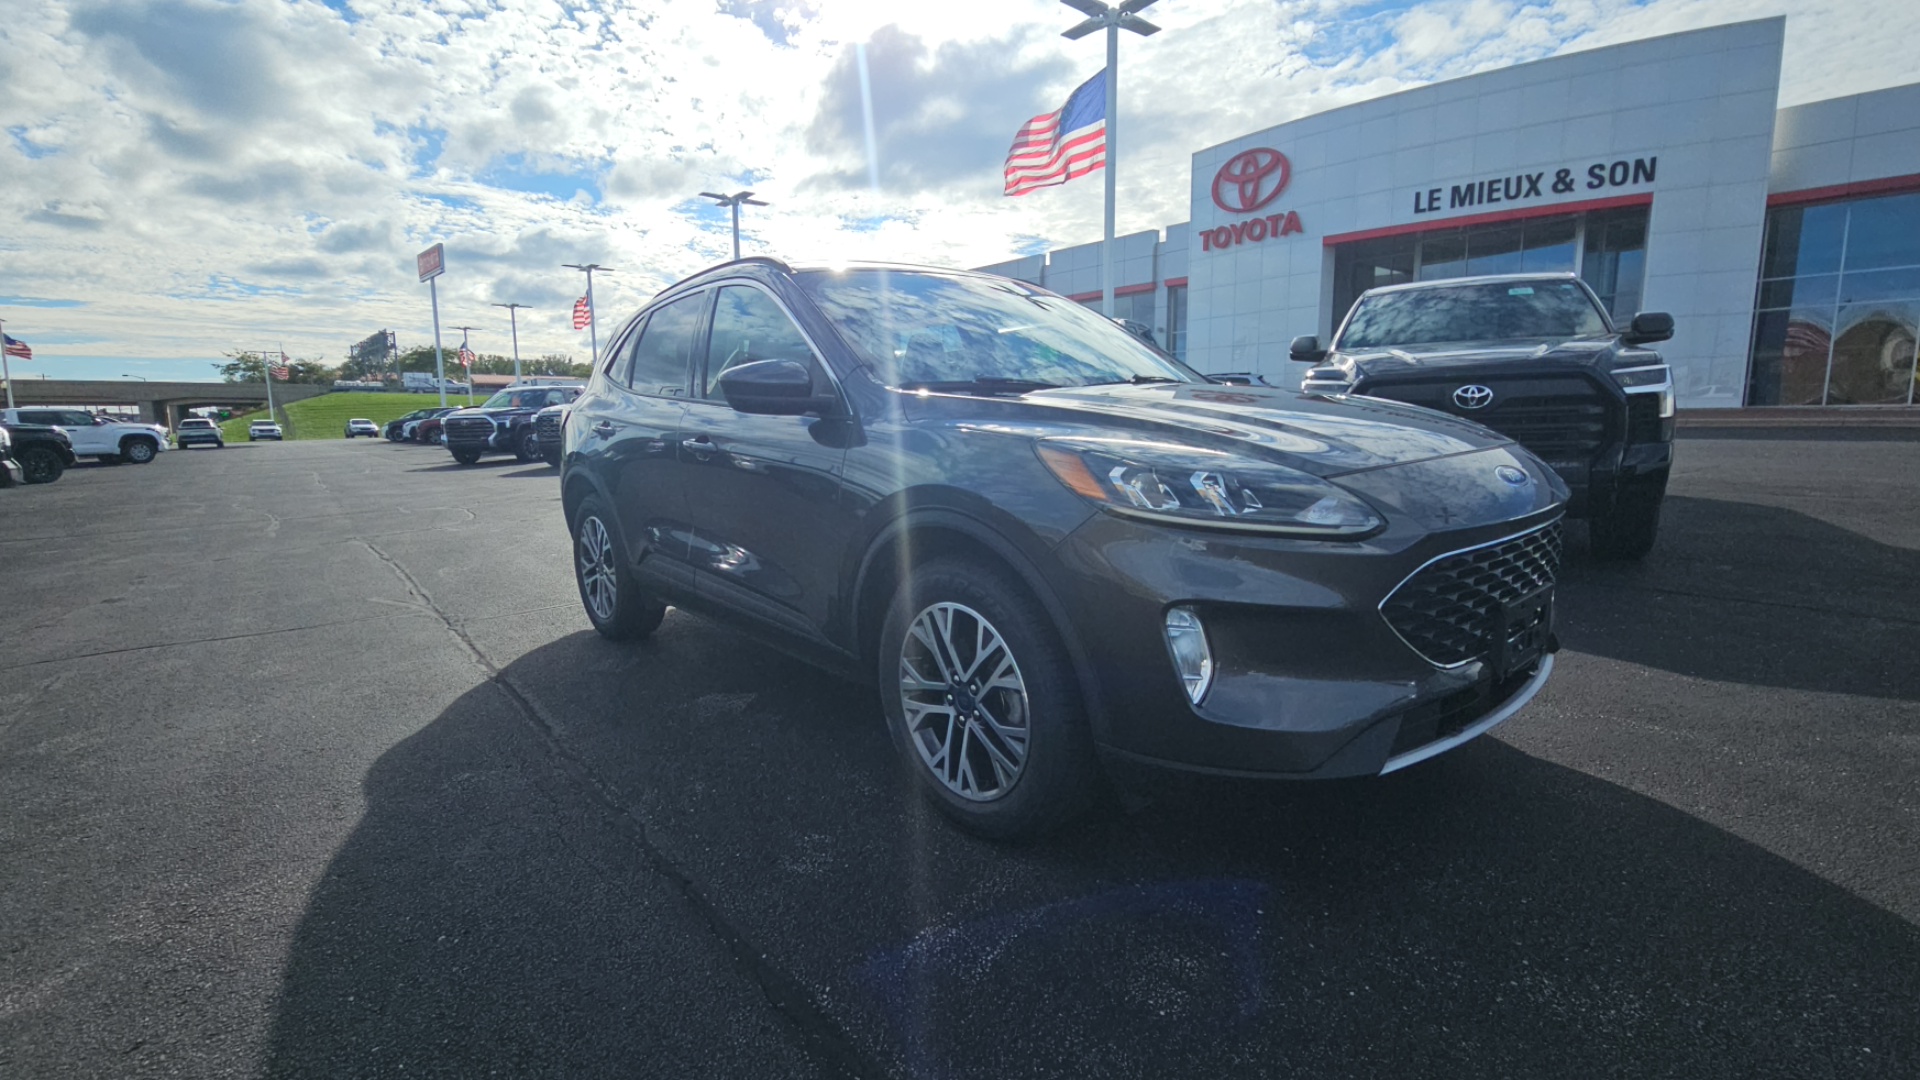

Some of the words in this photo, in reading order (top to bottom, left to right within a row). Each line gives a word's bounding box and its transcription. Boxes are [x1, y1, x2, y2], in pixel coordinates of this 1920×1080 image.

[1414, 188, 1442, 214] LE
[1450, 172, 1544, 209] MIEUX
[1551, 168, 1575, 194] &
[1587, 156, 1657, 190] SON
[1199, 210, 1303, 252] TOYOTA
